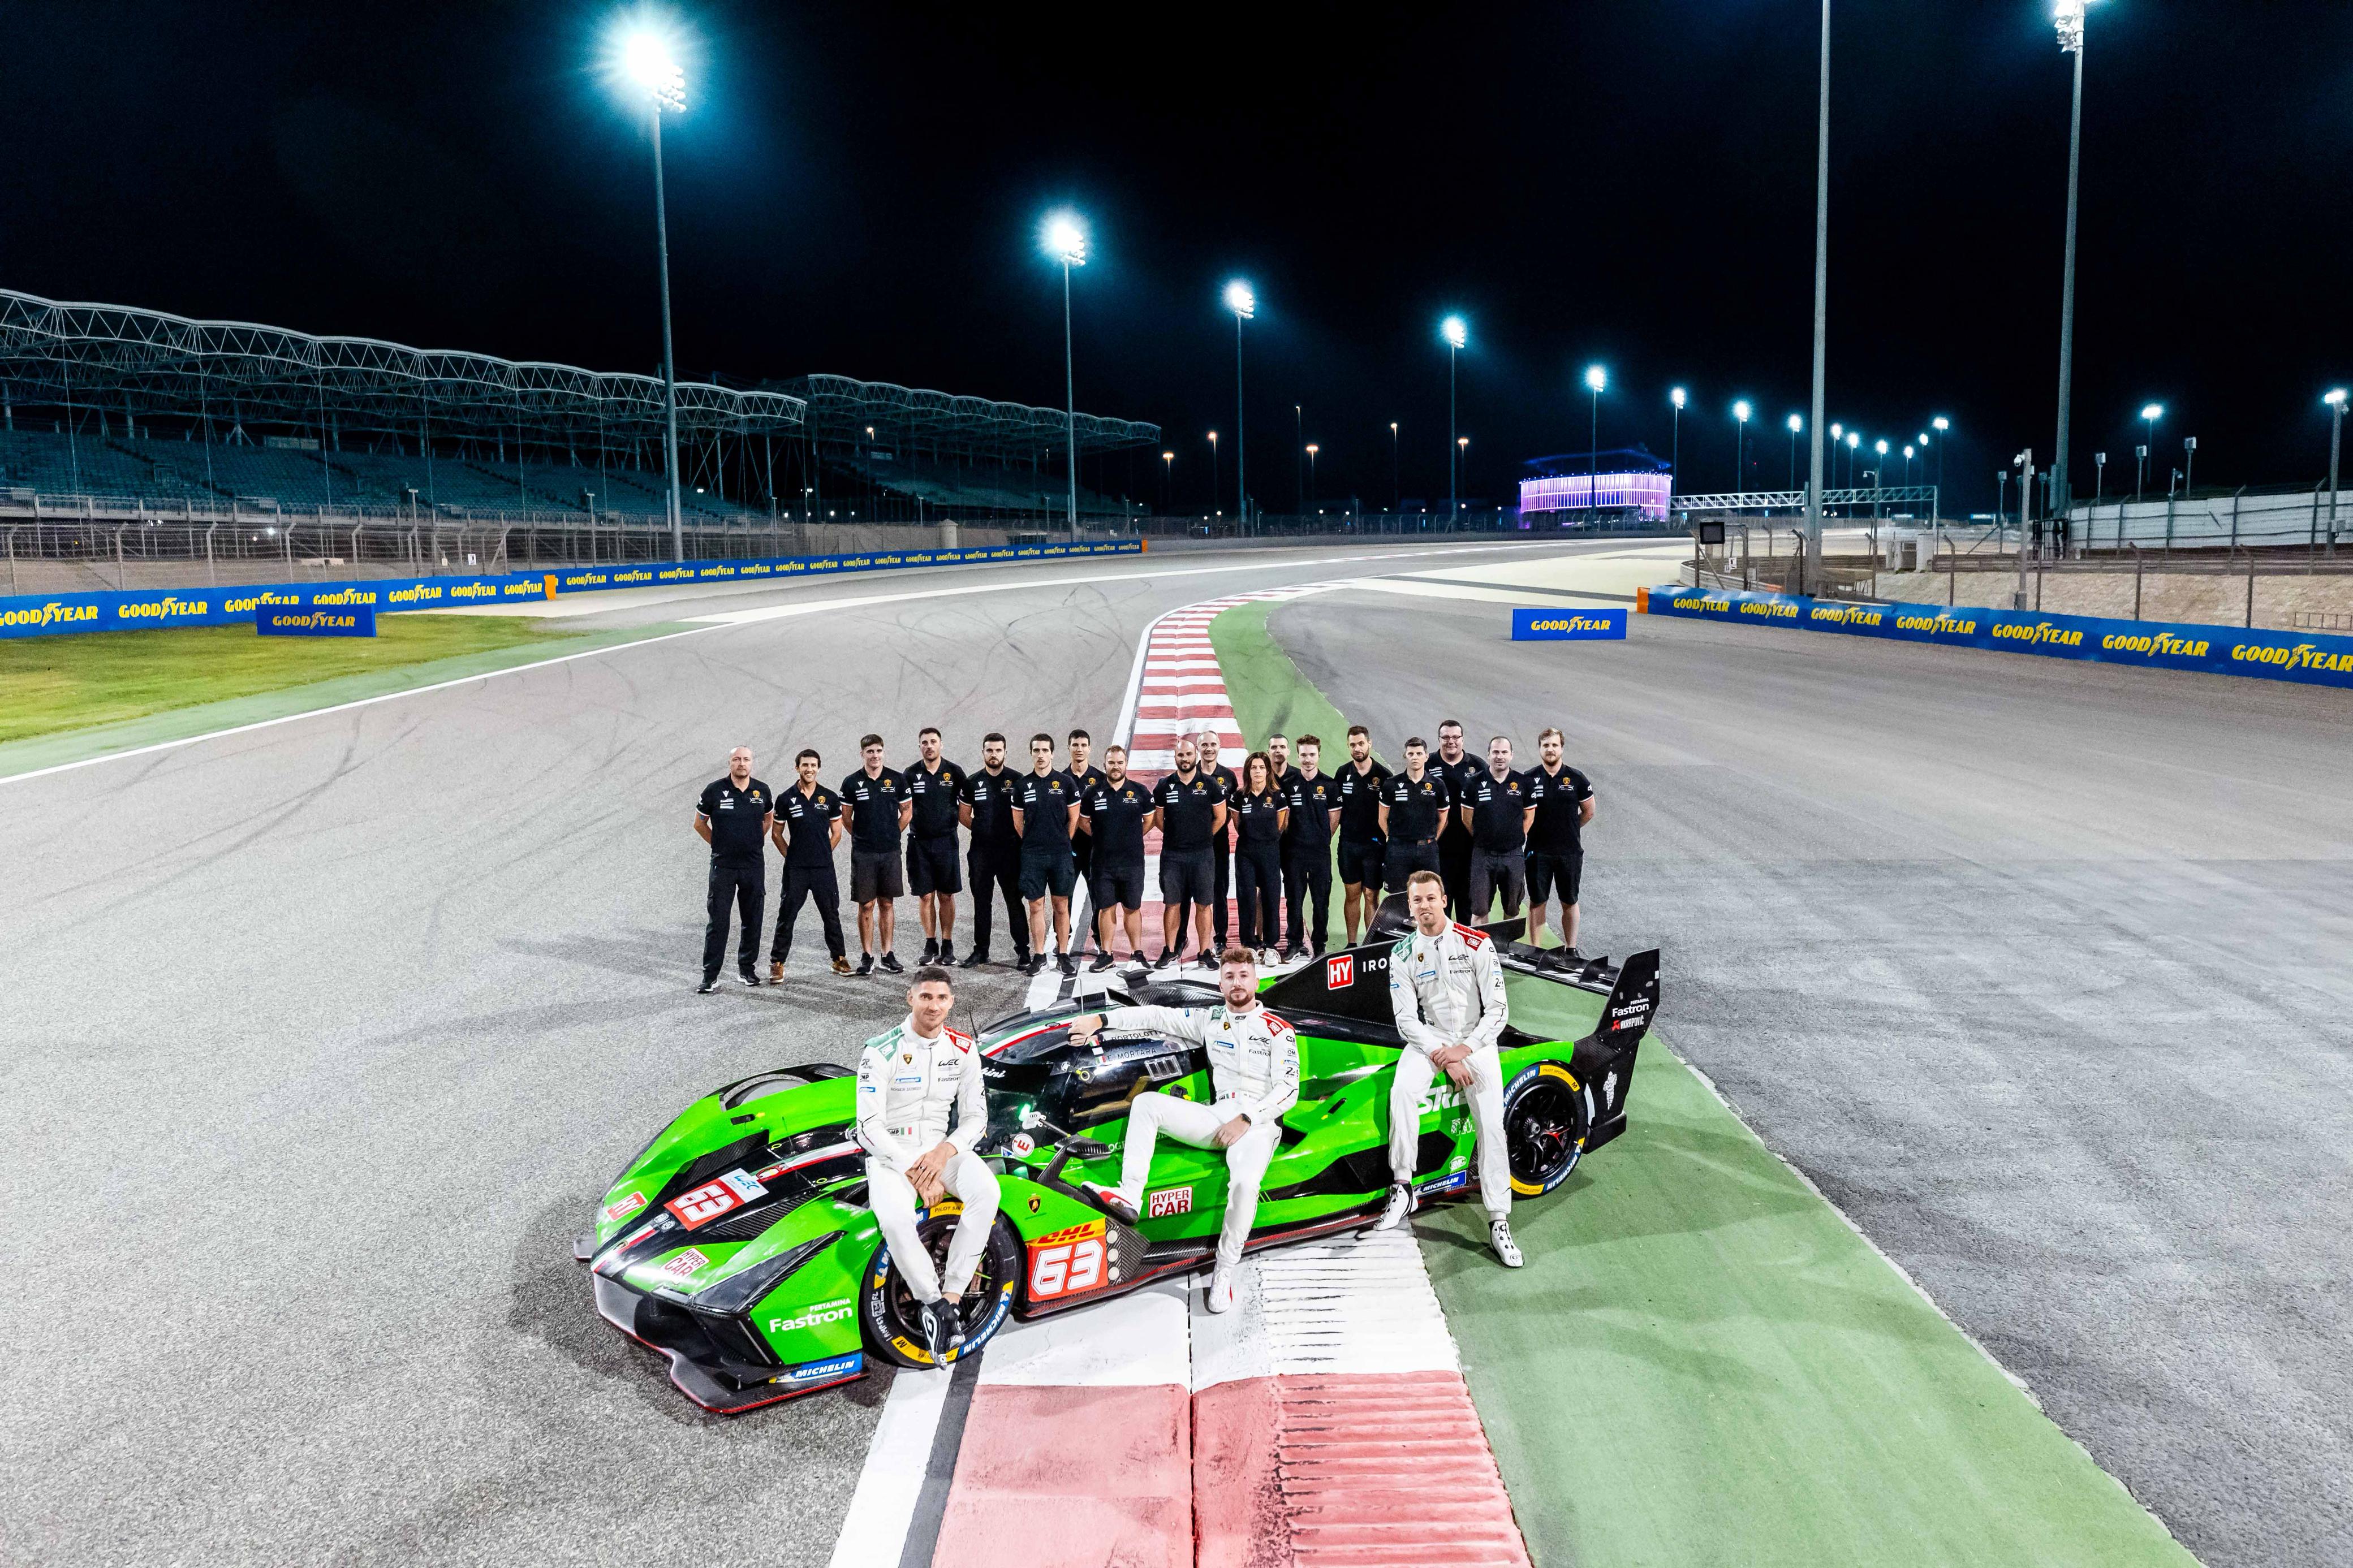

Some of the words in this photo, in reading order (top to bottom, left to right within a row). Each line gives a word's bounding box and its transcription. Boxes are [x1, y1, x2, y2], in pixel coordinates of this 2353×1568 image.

[659, 567, 694, 578] GOODYEAR
[700, 565, 735, 576] GOODYEAR
[740, 564, 770, 573] GOODYEAR
[775, 561, 805, 571] GOODYEAR
[809, 560, 838, 569] GOODYEAR
[566, 573, 606, 585] GOODYEAR
[614, 570, 652, 581] GOODYEAR
[313, 588, 376, 605] GOODYEAR
[389, 584, 442, 602] GOODYEAR
[450, 582, 496, 598] GOODYEAR
[504, 580, 542, 596] GOODYEAR
[118, 597, 207, 620] GOODYEAR
[1673, 595, 1729, 612] GOODYEAR
[1740, 600, 1798, 618] GOODYEAR
[273, 612, 355, 629] GOODYEAR
[1531, 616, 1610, 632] GOODYEAR
[1811, 606, 1882, 626] GOODYEAR
[1896, 614, 1976, 634] GOODYEAR
[1992, 622, 2083, 646] GOODYEAR
[2102, 632, 2209, 658] GOODYEAR
[2231, 643, 2353, 673] GOODYEAR
[1330, 961, 1351, 984] HY
[1612, 1003, 1649, 1017] Fastron
[1248, 1035, 1270, 1045] WEC
[1117, 1047, 1157, 1060] MORTARA
[938, 1059, 960, 1067] WEC
[1503, 1069, 1537, 1105] MICHELIN
[1546, 1154, 1578, 1190] MICHELIN
[734, 1175, 759, 1190] WEC
[1423, 1176, 1459, 1191] MICHELIN
[612, 1195, 640, 1215] HY
[674, 1184, 734, 1222] 63
[1152, 1189, 1190, 1204] HYPER
[1152, 1199, 1190, 1217] CAR
[1038, 1223, 1095, 1243] DHL
[664, 1257, 693, 1277] CAR
[681, 1250, 706, 1268] HYPER
[1031, 1239, 1103, 1296] 63
[809, 1298, 851, 1312] PERTAMINA
[769, 1307, 853, 1333] Fastron
[963, 1303, 1006, 1355] MICHELIN
[795, 1360, 855, 1378] MICHELIN
